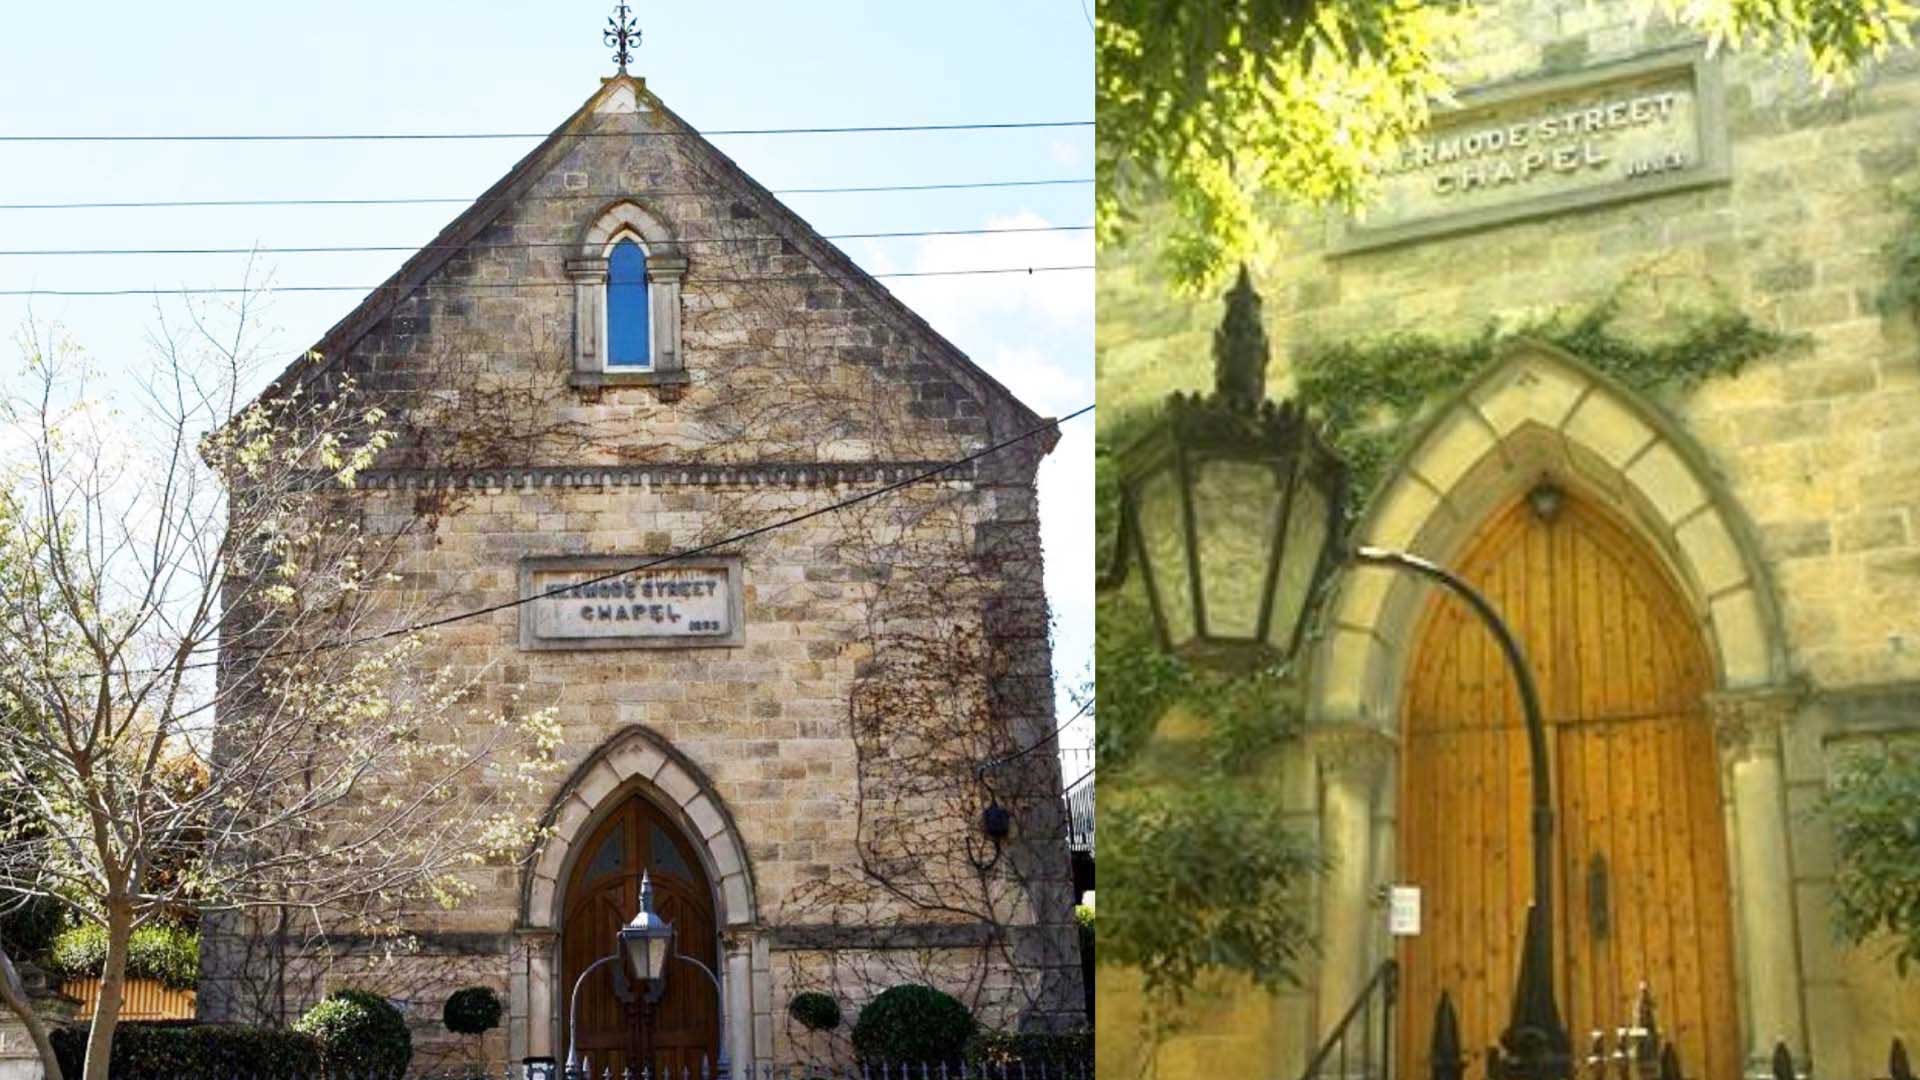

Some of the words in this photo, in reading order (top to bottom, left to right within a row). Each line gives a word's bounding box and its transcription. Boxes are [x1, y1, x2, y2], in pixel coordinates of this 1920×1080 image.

[1376, 124, 1529, 176] ERMODE
[1537, 94, 1677, 143] STREET
[1433, 143, 1609, 194] CHAPEL
[641, 580, 717, 598] STREET
[579, 604, 682, 624] CHAPEL
